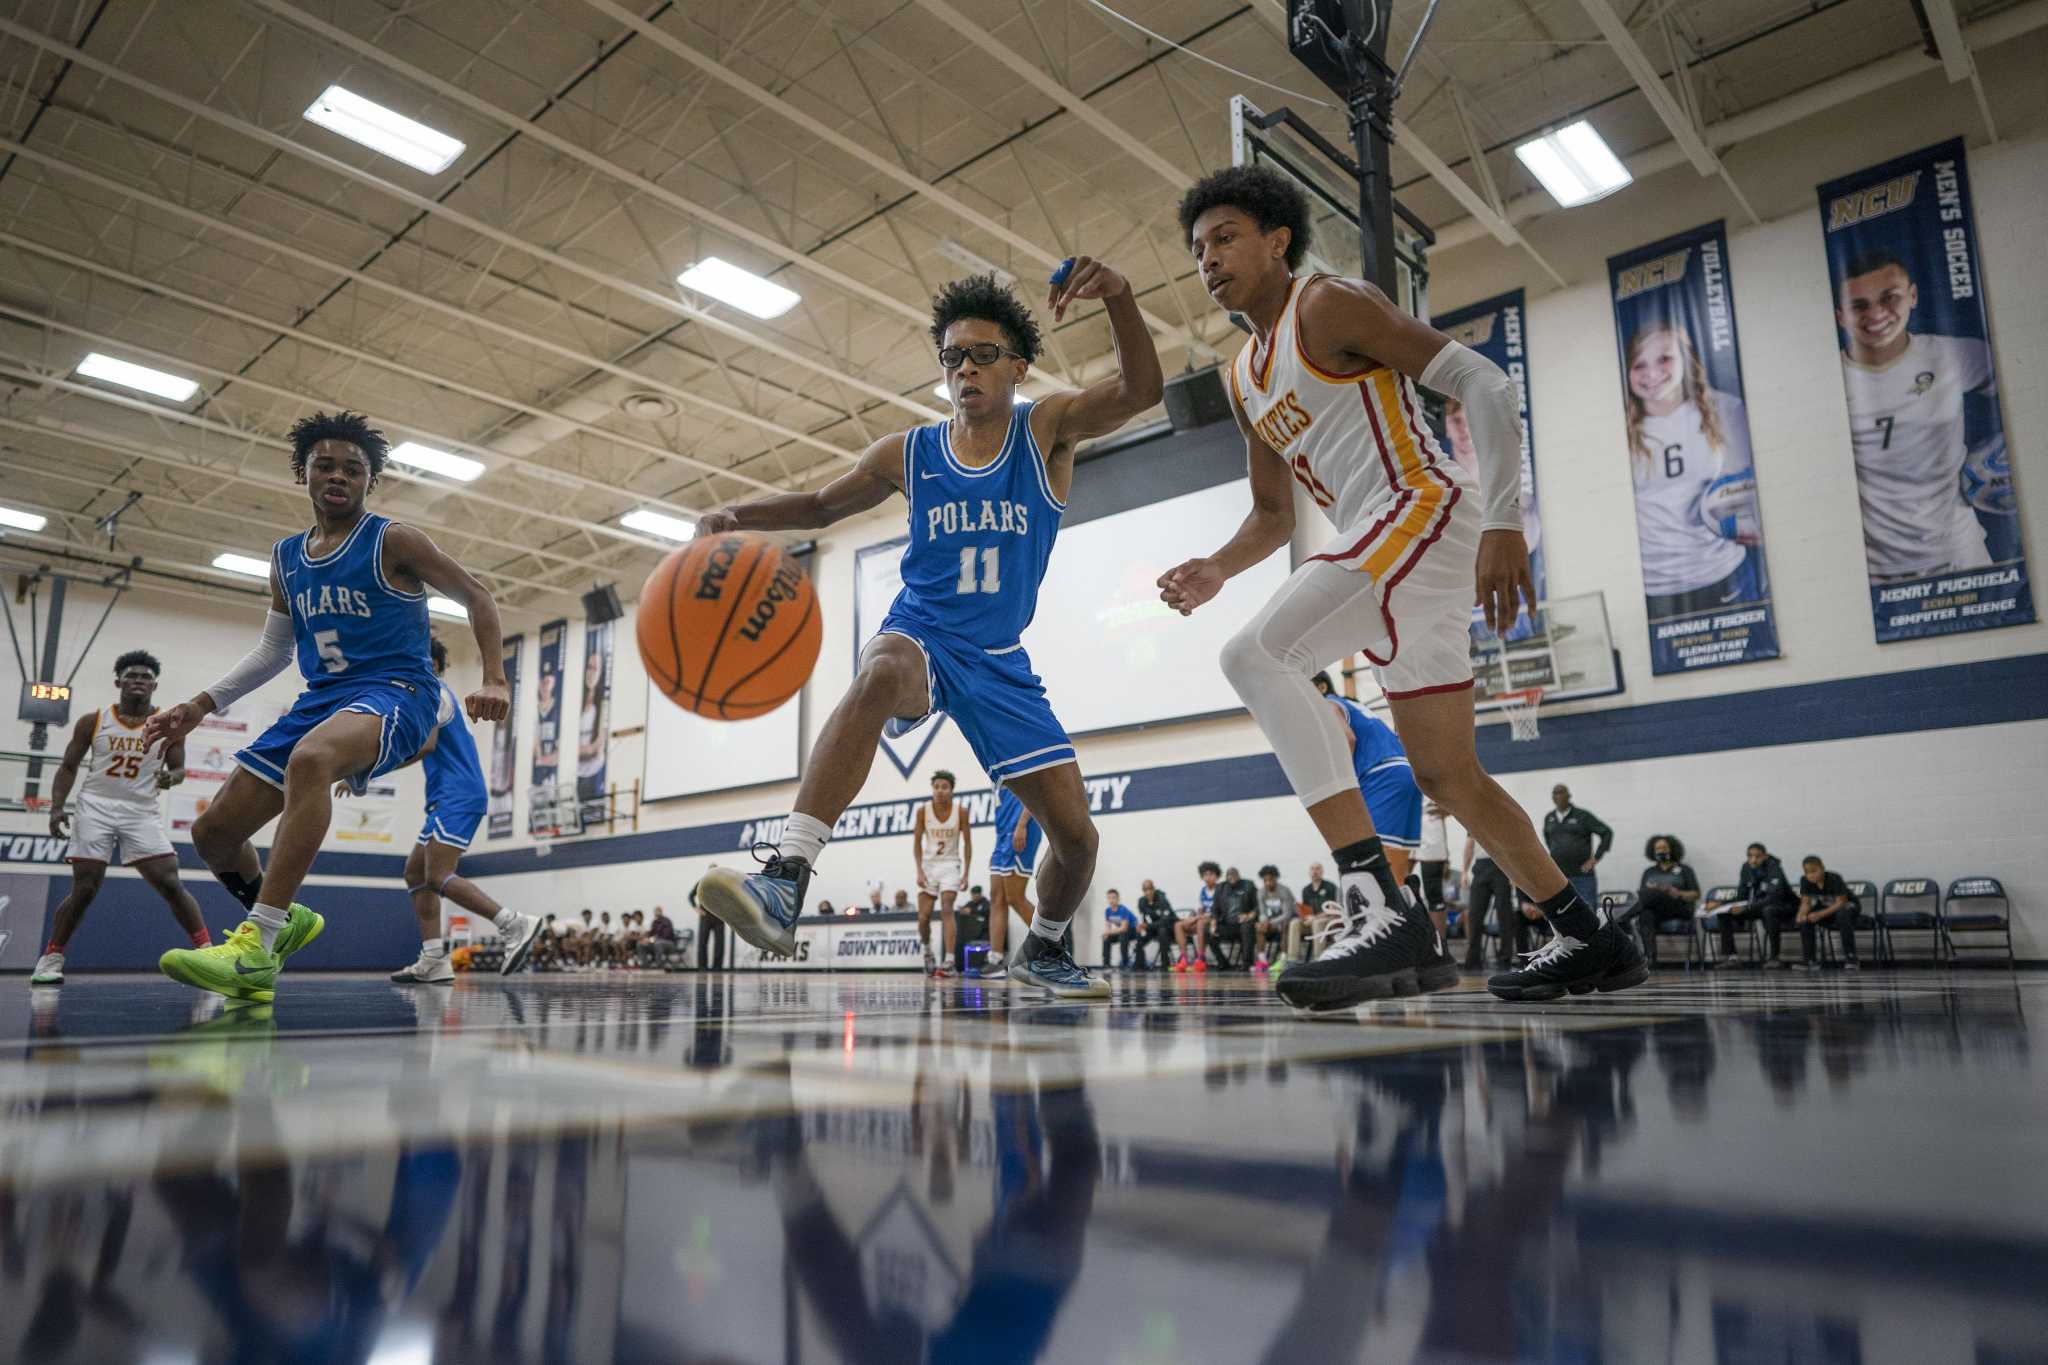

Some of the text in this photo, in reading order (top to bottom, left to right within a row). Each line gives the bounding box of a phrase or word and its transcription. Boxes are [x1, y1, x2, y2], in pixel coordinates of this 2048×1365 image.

[1829, 169, 1922, 232] NCU
[1934, 160, 1973, 300] MEN'S SOCCER
[1616, 247, 1692, 300] NCU
[1701, 240, 1730, 351] VOLLEYBALL
[1876, 416, 1895, 450] 7
[1664, 444, 1684, 478] 6
[927, 500, 1028, 542] POLARS
[956, 545, 1001, 594] 11
[1880, 583, 1933, 603] HENRY
[1889, 598, 2016, 627] COMPUTER SCIENCE
[314, 629, 349, 673] 5
[1678, 638, 1750, 659] ELEMENTARY
[1685, 649, 1744, 667] EDUCATION
[108, 735, 143, 752] YATE
[106, 755, 143, 779] 25
[832, 801, 925, 838] CENTRA
[936, 841, 945, 855] 2
[837, 939, 921, 956] DOWNTOWN
